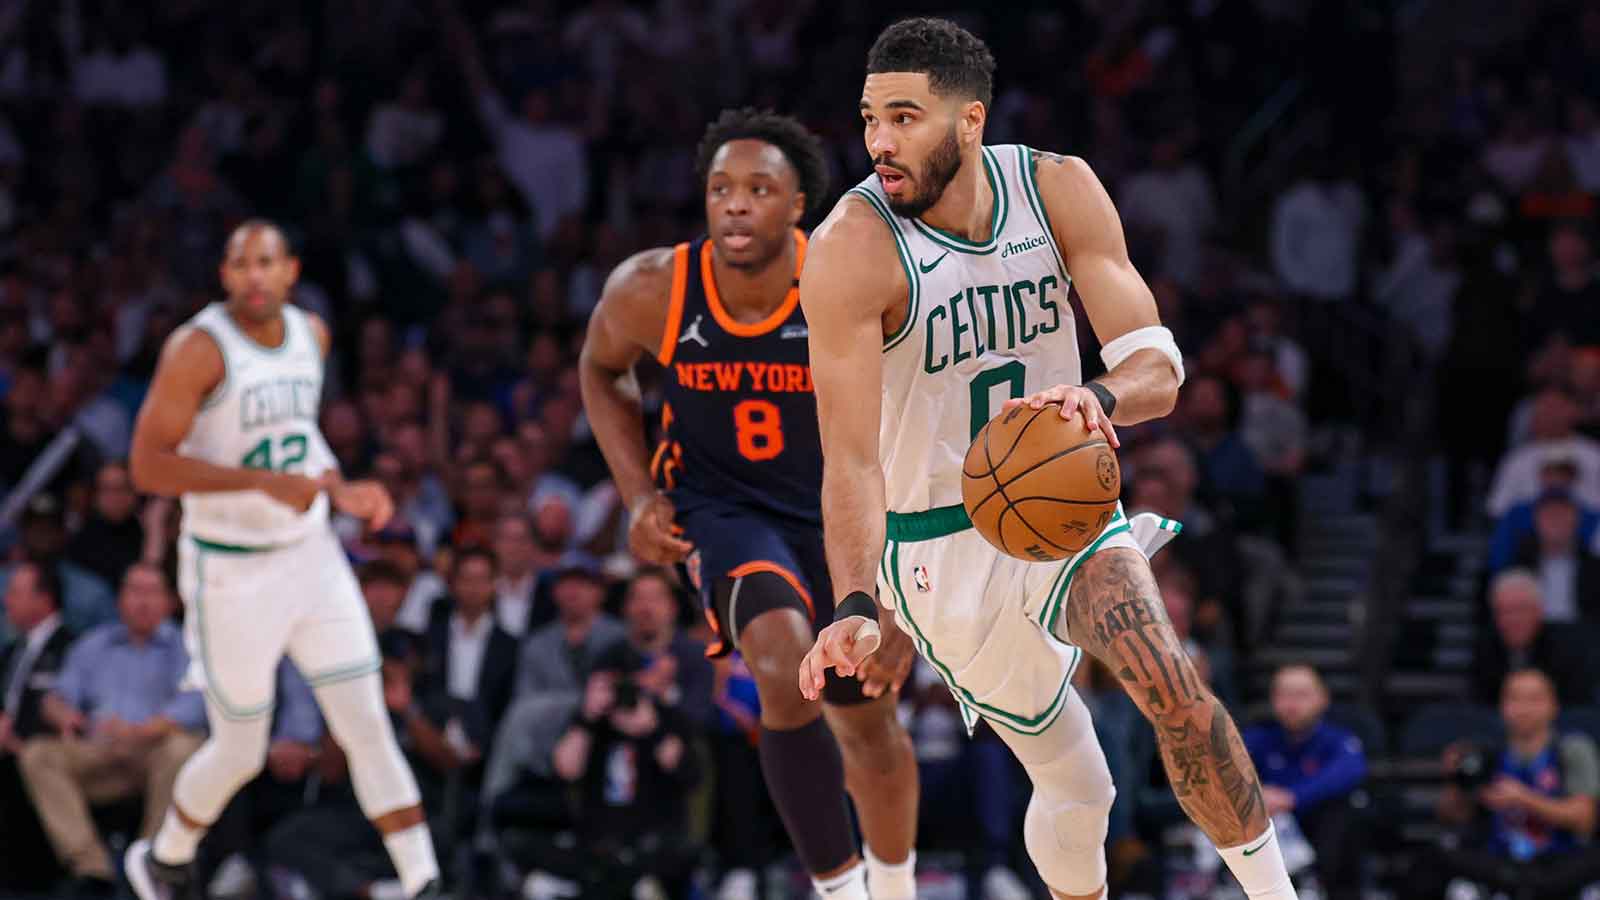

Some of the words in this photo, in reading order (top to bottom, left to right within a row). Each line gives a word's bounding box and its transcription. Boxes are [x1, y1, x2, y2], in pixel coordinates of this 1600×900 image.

[1001, 234, 1047, 258] Amica
[924, 275, 1060, 374] CELTICS
[674, 361, 742, 392] NEW
[733, 399, 785, 462] 8
[242, 433, 308, 471] 42
